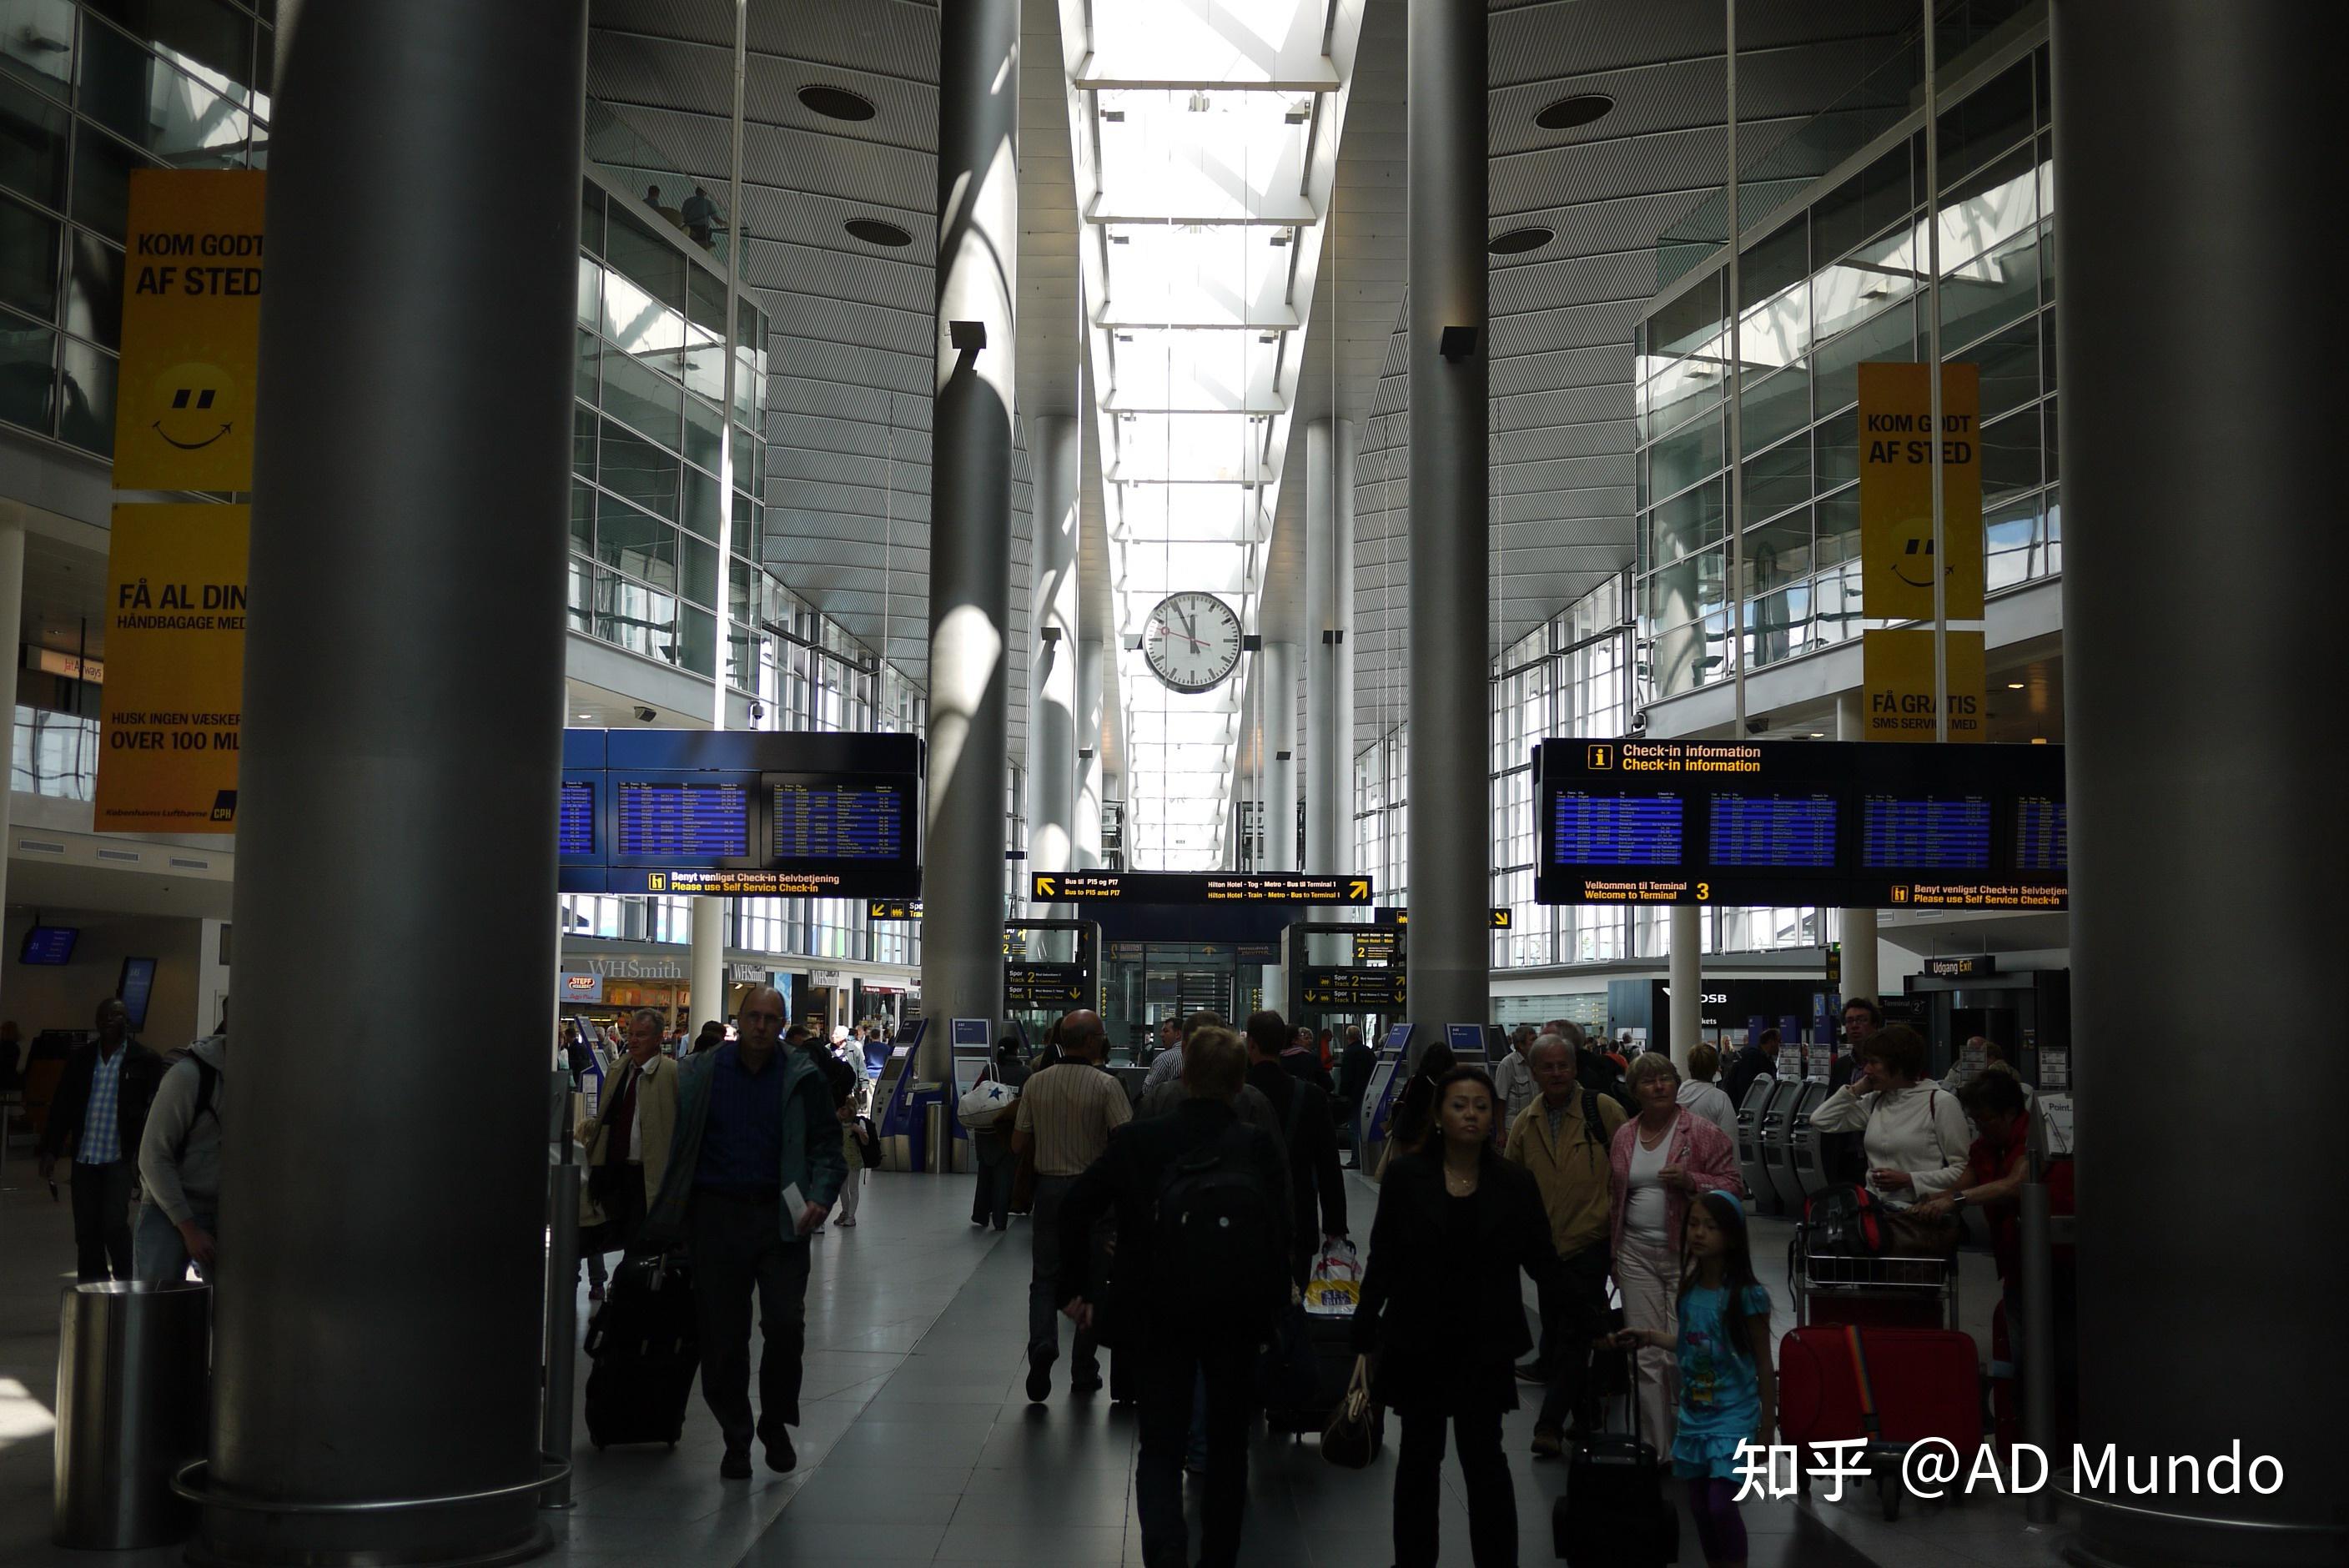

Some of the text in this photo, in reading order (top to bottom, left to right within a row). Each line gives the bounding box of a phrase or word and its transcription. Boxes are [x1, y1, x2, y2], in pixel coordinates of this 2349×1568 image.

[138, 234, 263, 256] KOM GODT
[136, 267, 261, 295] AF STED
[1869, 415, 1971, 432] KOM GDT
[1869, 440, 1971, 464] AF STED
[119, 578, 247, 610] FÅ AL DIN
[118, 614, 214, 630] HÅNDBAGAGE
[1873, 689, 1976, 714] FÅ GRTIS
[112, 713, 145, 725] HUSK
[150, 713, 188, 725] INGEN
[1873, 718, 1977, 730] SMS SERVI MED
[111, 731, 239, 750] OVER 100 ML
[1623, 744, 1761, 758] Check-in information
[1622, 758, 1760, 771] Check-in information
[214, 809, 231, 818] CPH
[672, 872, 840, 885] Benyt venligst Check-in Selvbetjening
[1248, 881, 1259, 889] Tog
[672, 882, 702, 891] Please
[723, 882, 741, 892] Self
[743, 883, 777, 892] Service
[779, 884, 818, 893] Check-in
[1585, 881, 1687, 890] Velkommen til Terminal
[1697, 882, 1709, 900] 3
[1914, 884, 2069, 897] Benyt venligst Check-in Selvbetjen
[1585, 890, 1626, 899] Welcome
[1639, 891, 1677, 899] Terminal
[1965, 895, 1982, 903] Self
[1985, 896, 2018, 904] Service
[2020, 897, 2060, 905] Check-in
[1003, 944, 1009, 954] 2
[1357, 947, 1365, 957] 2
[587, 960, 681, 978] WHSmith
[734, 963, 766, 982] WHSmith
[1933, 961, 1973, 974] Udgang Exit
[1027, 972, 1034, 983] 2
[1351, 976, 1359, 987] 2
[1028, 988, 1032, 998] 1
[1352, 992, 1357, 1003] 1
[1700, 993, 1728, 1003] DSB
